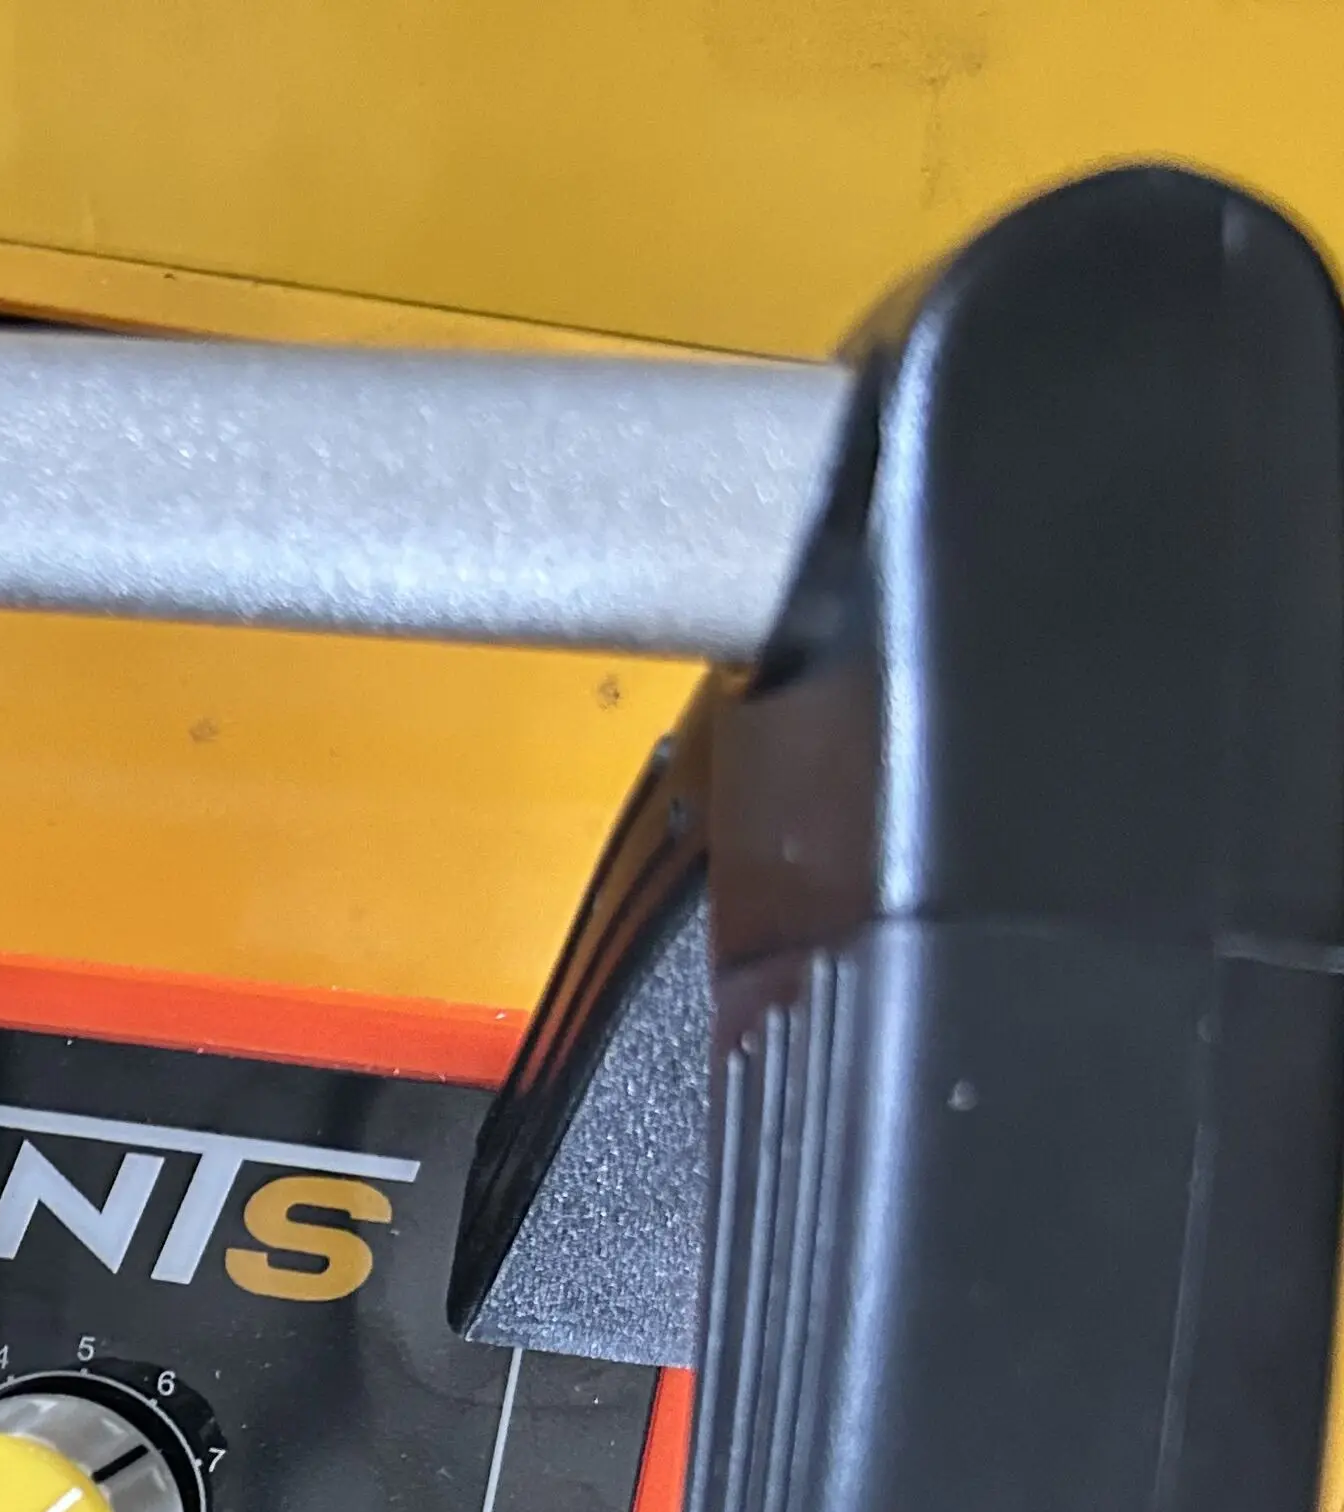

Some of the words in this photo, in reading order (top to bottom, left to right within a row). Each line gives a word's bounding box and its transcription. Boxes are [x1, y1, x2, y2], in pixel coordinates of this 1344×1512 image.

[76, 1337, 96, 1362] 5
[155, 1370, 177, 1397] 6
[207, 1448, 227, 1474] 7
